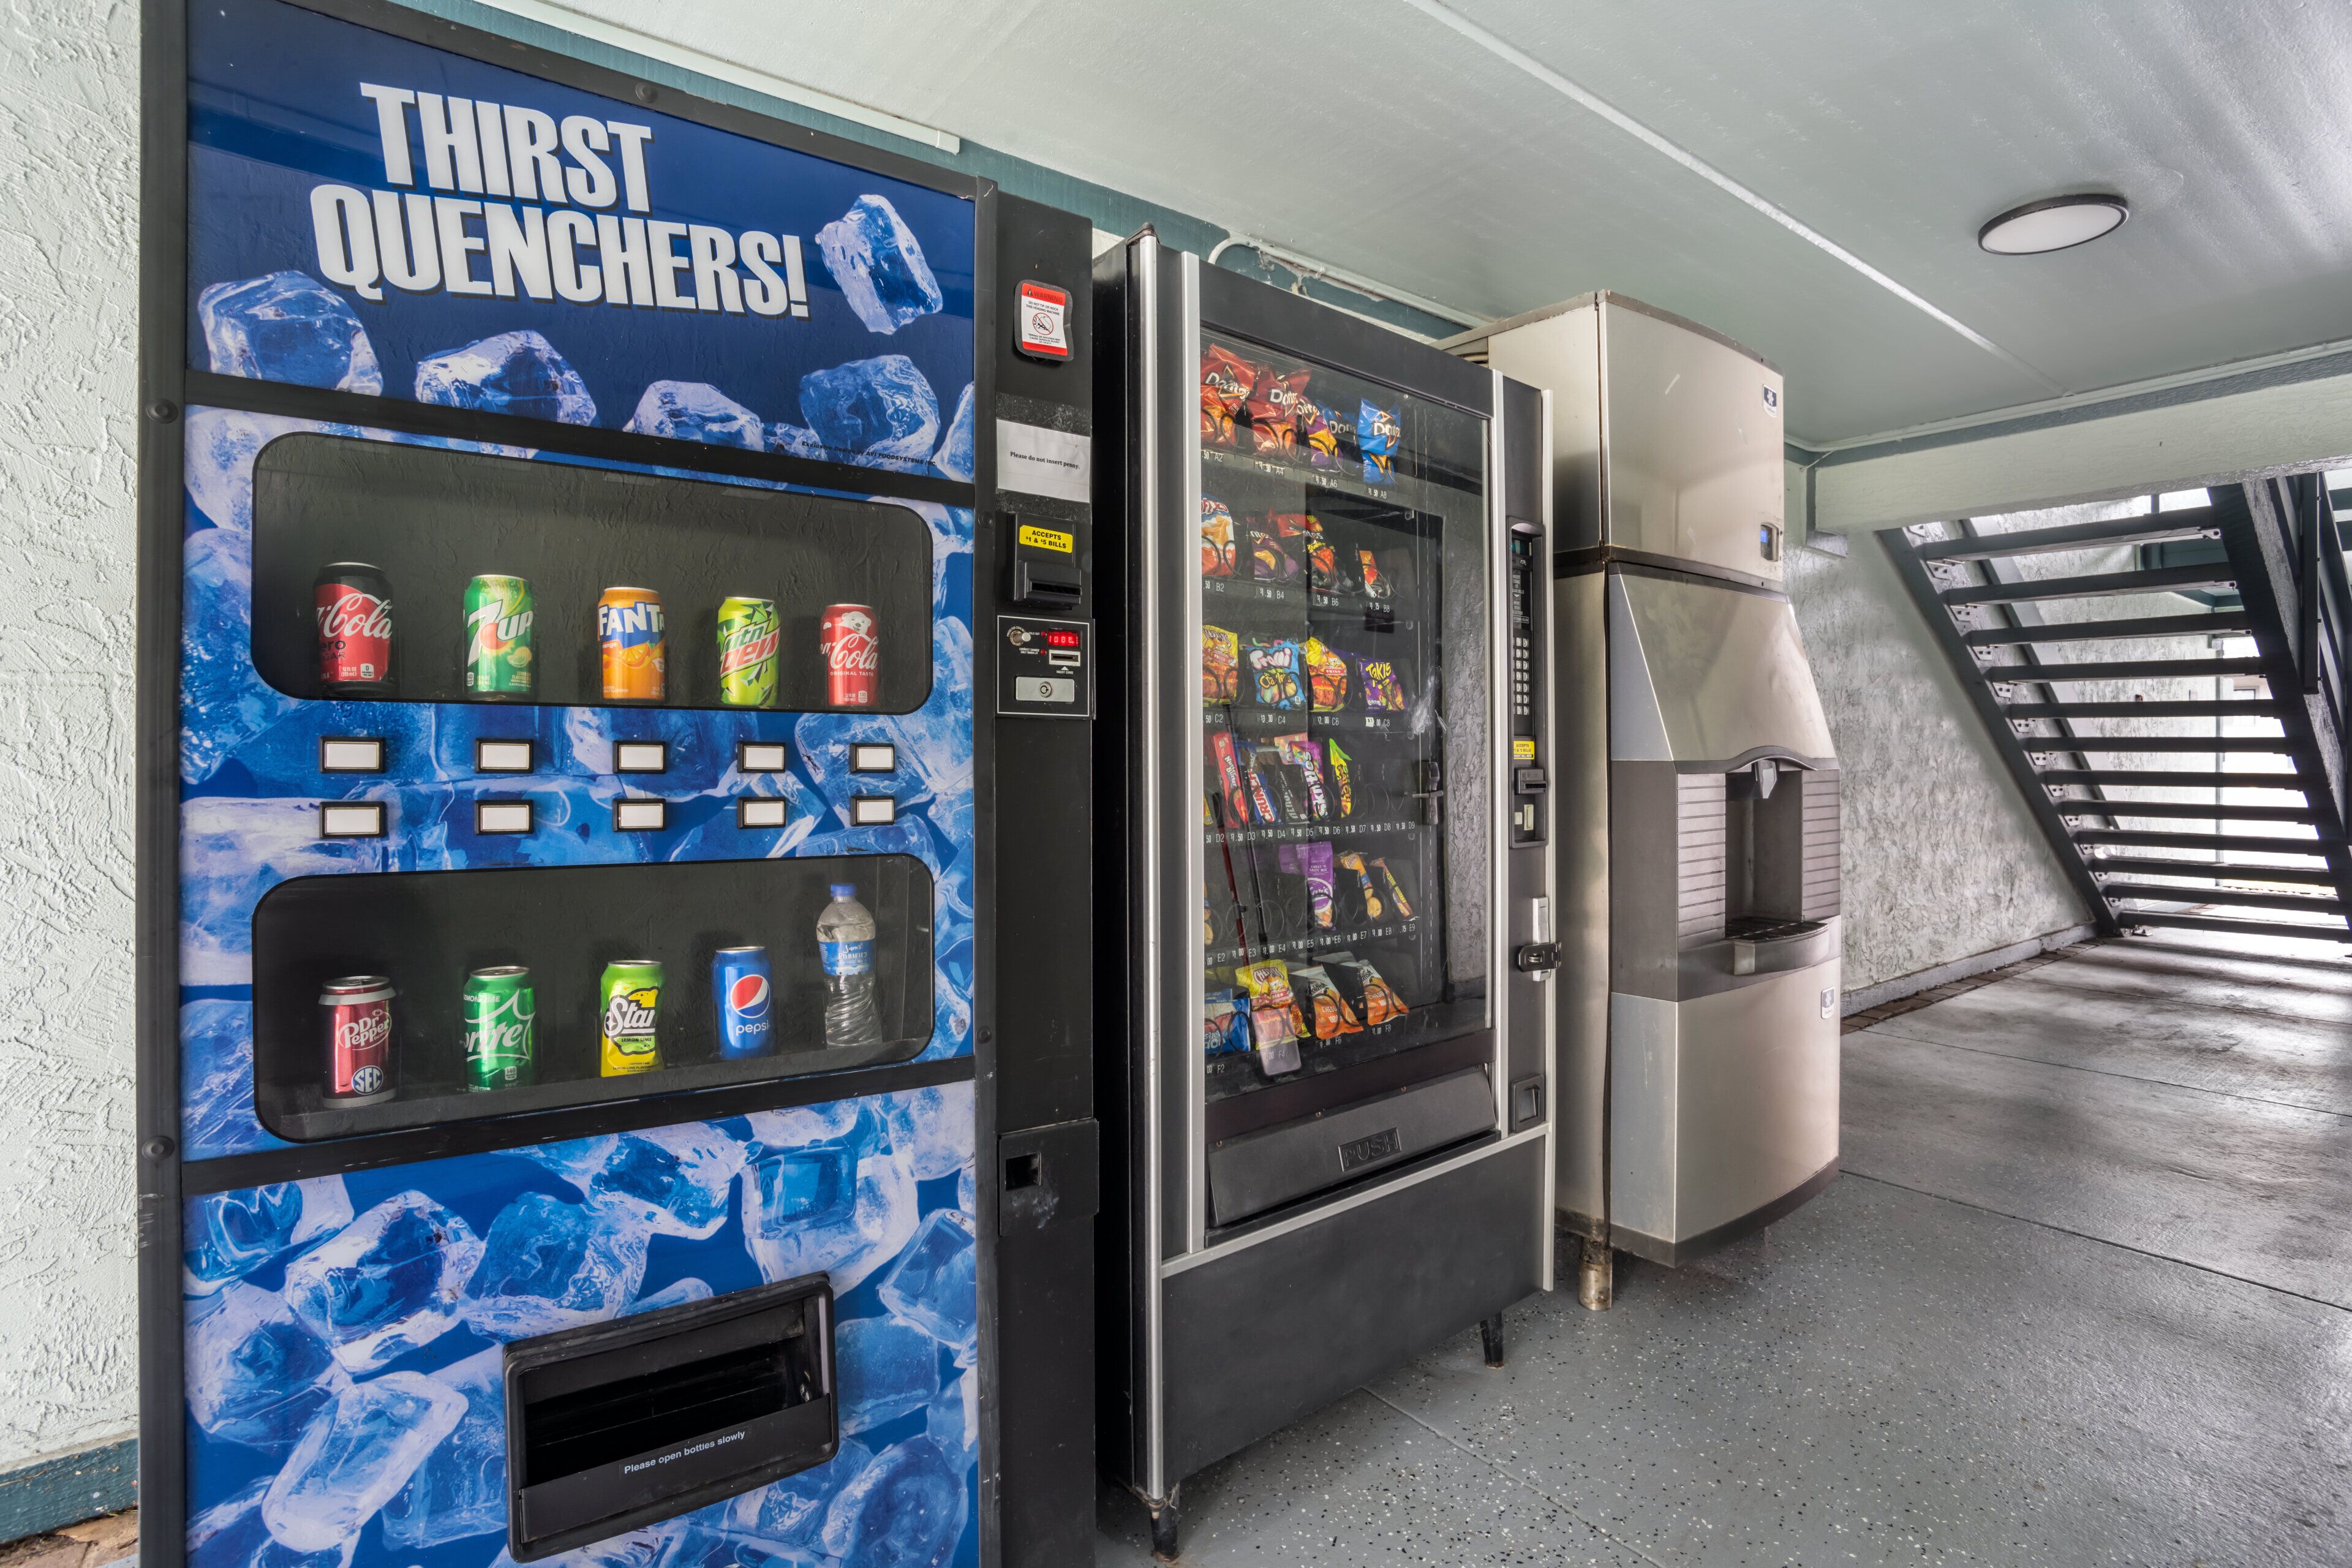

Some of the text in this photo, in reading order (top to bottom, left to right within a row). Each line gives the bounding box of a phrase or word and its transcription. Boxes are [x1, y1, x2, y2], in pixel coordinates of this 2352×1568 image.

[360, 82, 652, 213] THIRST
[310, 184, 810, 318] QUENCHERS!
[1034, 291, 1063, 303] WARNING
[802, 441, 832, 450] Exclusive
[878, 453, 924, 464] FOODSYSTEMS
[1215, 453, 1223, 462] A2
[1276, 467, 1284, 475] A4
[1330, 478, 1338, 488] A6
[1381, 491, 1387, 499] A8
[1032, 530, 1061, 540] ACCEPTS
[1049, 540, 1066, 549] BILLS
[1216, 583, 1224, 592] B2
[1277, 590, 1284, 599] B4
[1383, 604, 1390, 612] B8
[598, 603, 665, 636] FANTA
[1259, 673, 1292, 689] Crales
[1215, 714, 1223, 723] C2
[1248, 832, 1256, 840] D3
[1278, 830, 1286, 839] D4
[1306, 827, 1313, 837] D5
[1216, 834, 1224, 842] D2
[1334, 935, 1341, 943] E6
[1360, 931, 1366, 940] E7
[1248, 948, 1256, 957] E3
[1279, 944, 1286, 952] E4
[1217, 953, 1225, 962] E2
[358, 1017, 379, 1033] Dr
[736, 1020, 769, 1036] pepsi
[344, 1019, 390, 1049] Pepper
[1335, 1036, 1341, 1045] F6
[1279, 1050, 1285, 1058] F4
[1217, 1064, 1224, 1073] F2
[353, 1068, 381, 1093] SEC
[1343, 1132, 1398, 1167] PUSH
[624, 1431, 745, 1474] Please open bottles slowly
